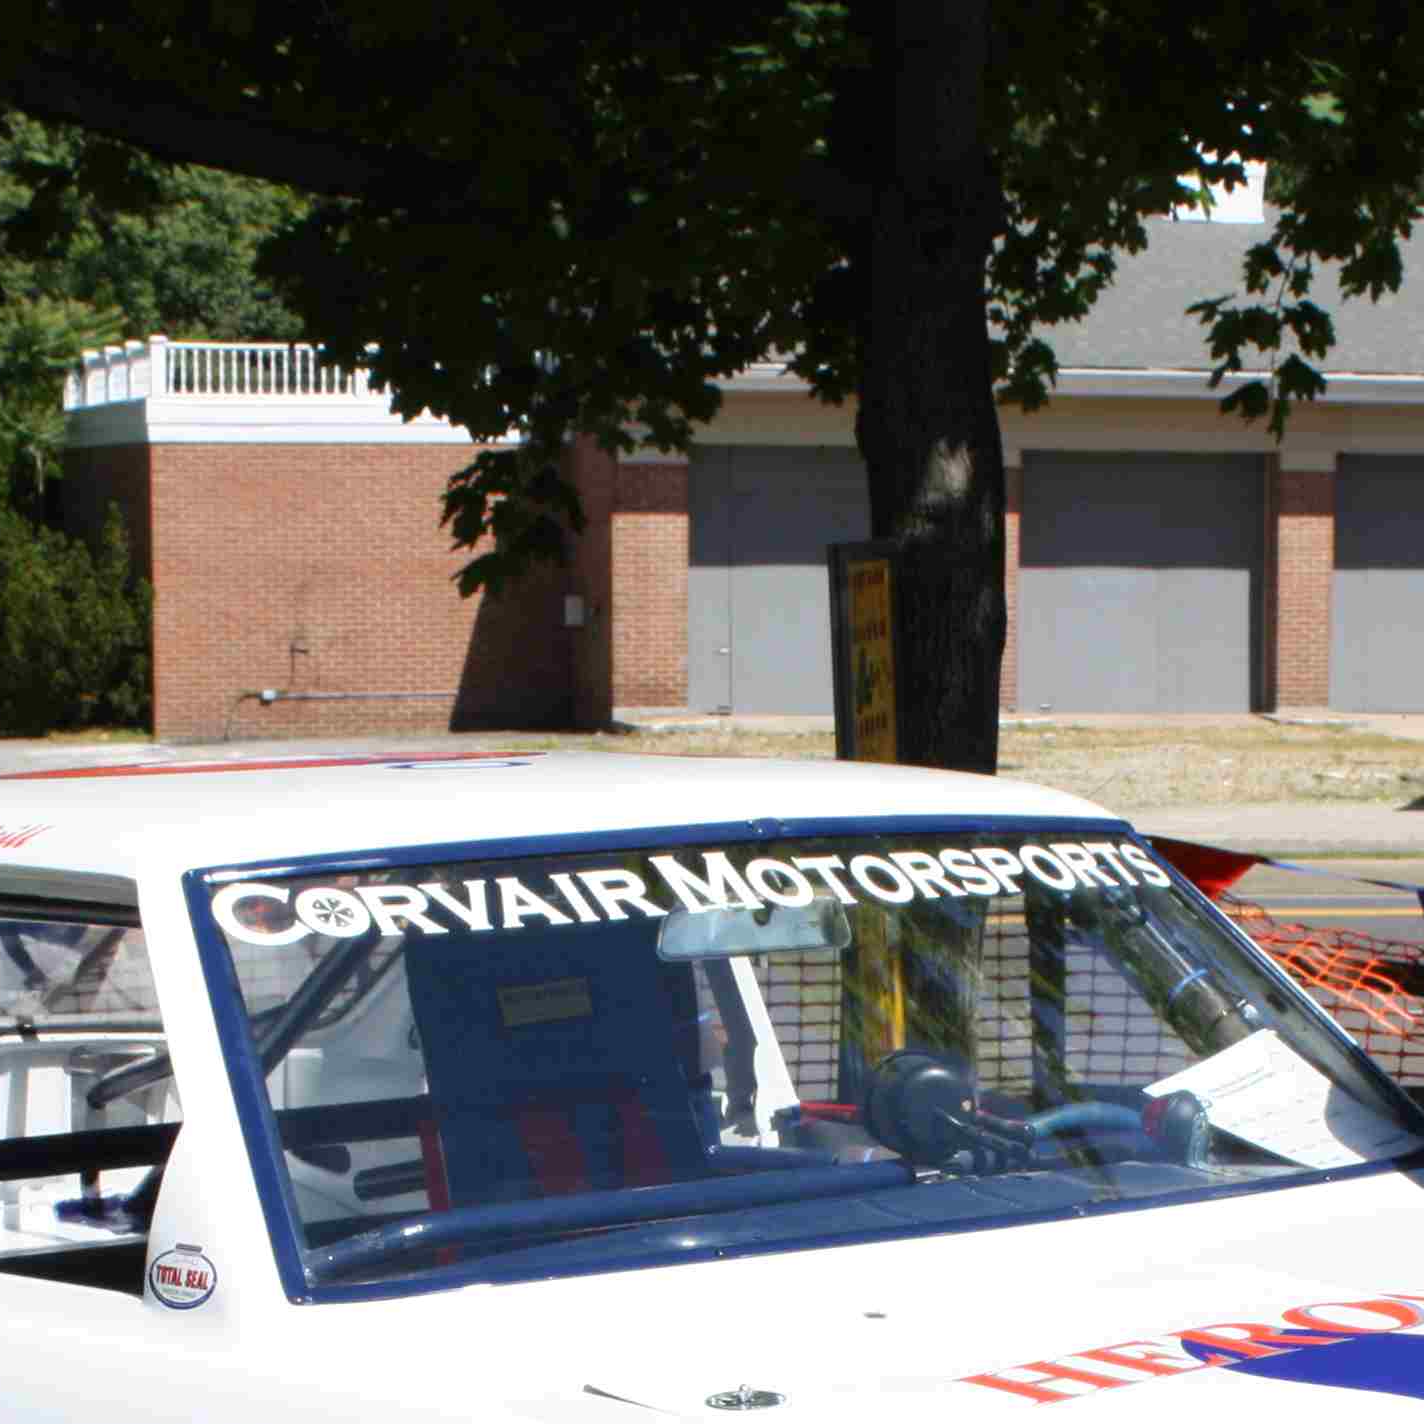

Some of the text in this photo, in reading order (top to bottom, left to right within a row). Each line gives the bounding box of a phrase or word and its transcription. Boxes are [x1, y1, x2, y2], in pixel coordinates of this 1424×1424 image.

[212, 843, 1171, 946] CORVAIR MOTORSPORTS
[156, 1264, 208, 1291] TOTAL SEAL
